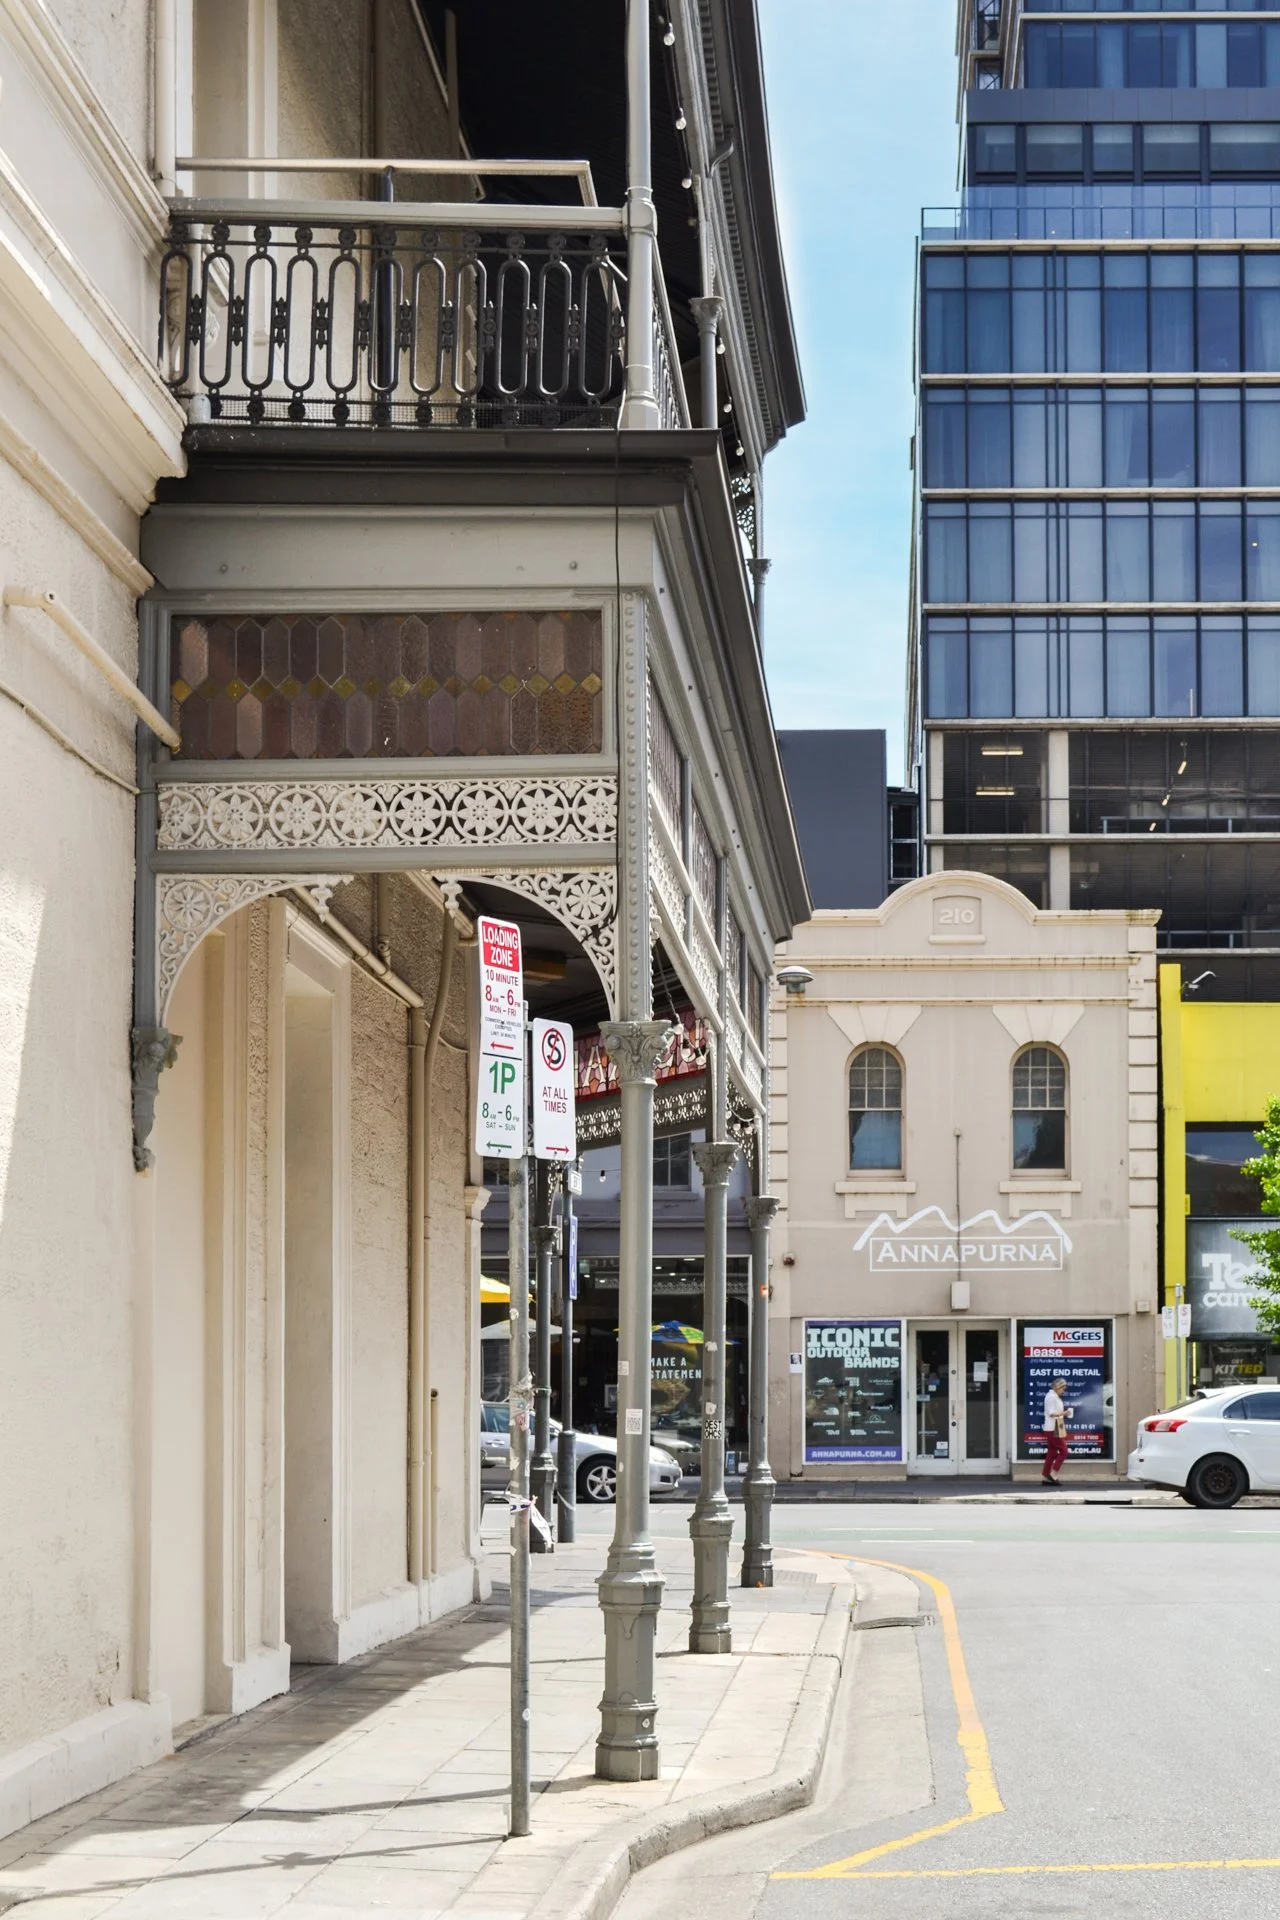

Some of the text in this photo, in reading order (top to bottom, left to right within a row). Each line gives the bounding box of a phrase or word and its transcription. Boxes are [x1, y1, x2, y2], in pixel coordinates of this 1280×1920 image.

[939, 908, 975, 924] 210
[482, 925, 519, 950] LOADING
[490, 946, 513, 967] ZONE
[486, 969, 519, 987] 10 MINUTE
[489, 1004, 502, 1014] MON
[507, 1007, 517, 1017] FRI
[489, 1060, 516, 1095] 1P
[542, 1086, 568, 1101] AT ALL
[543, 1100, 567, 1114] TIMES
[485, 1121, 496, 1129] SAT
[504, 1123, 516, 1131] SUN
[876, 1241, 1058, 1263] ANNAPURNA
[806, 1327, 900, 1348] ICONIC
[806, 1347, 870, 1358] OUTDOOR
[1030, 1346, 1063, 1357] lease
[650, 1357, 687, 1367] MAKE A
[844, 1356, 900, 1368] BRANDS
[650, 1369, 702, 1379] STATEMEN
[1030, 1368, 1101, 1376] EAST END RETAIL
[1215, 1364, 1263, 1374] KITTED
